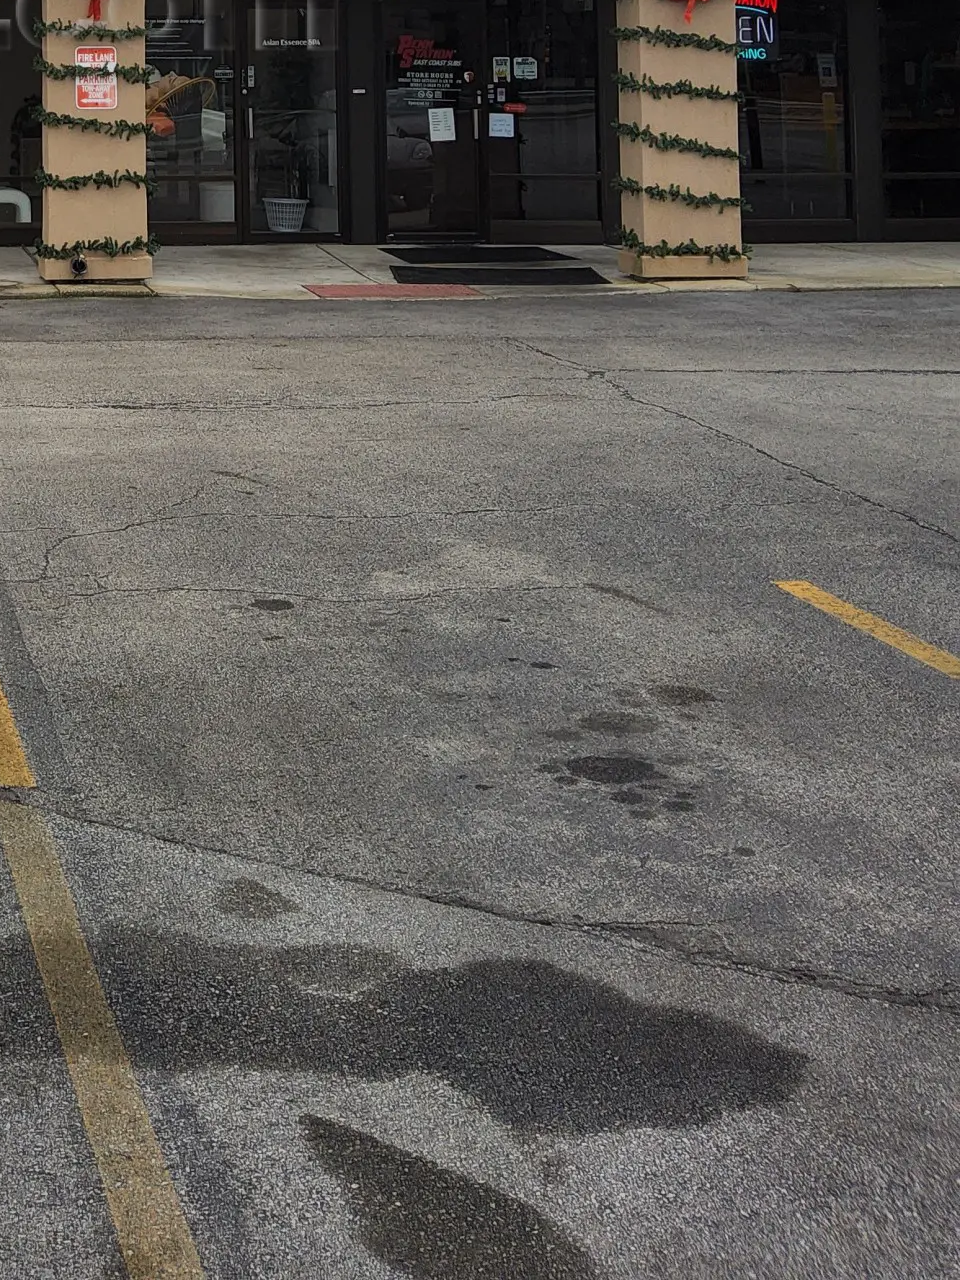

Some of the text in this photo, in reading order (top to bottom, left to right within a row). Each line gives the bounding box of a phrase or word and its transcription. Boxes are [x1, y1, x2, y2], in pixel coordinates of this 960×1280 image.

[739, 16, 774, 44] EN
[262, 38, 321, 46] Asian Essence SPA
[78, 53, 114, 62] FIRE LANE
[399, 48, 453, 68] STATION
[79, 74, 114, 84] PARKING
[88, 91, 105, 99] ZONE
